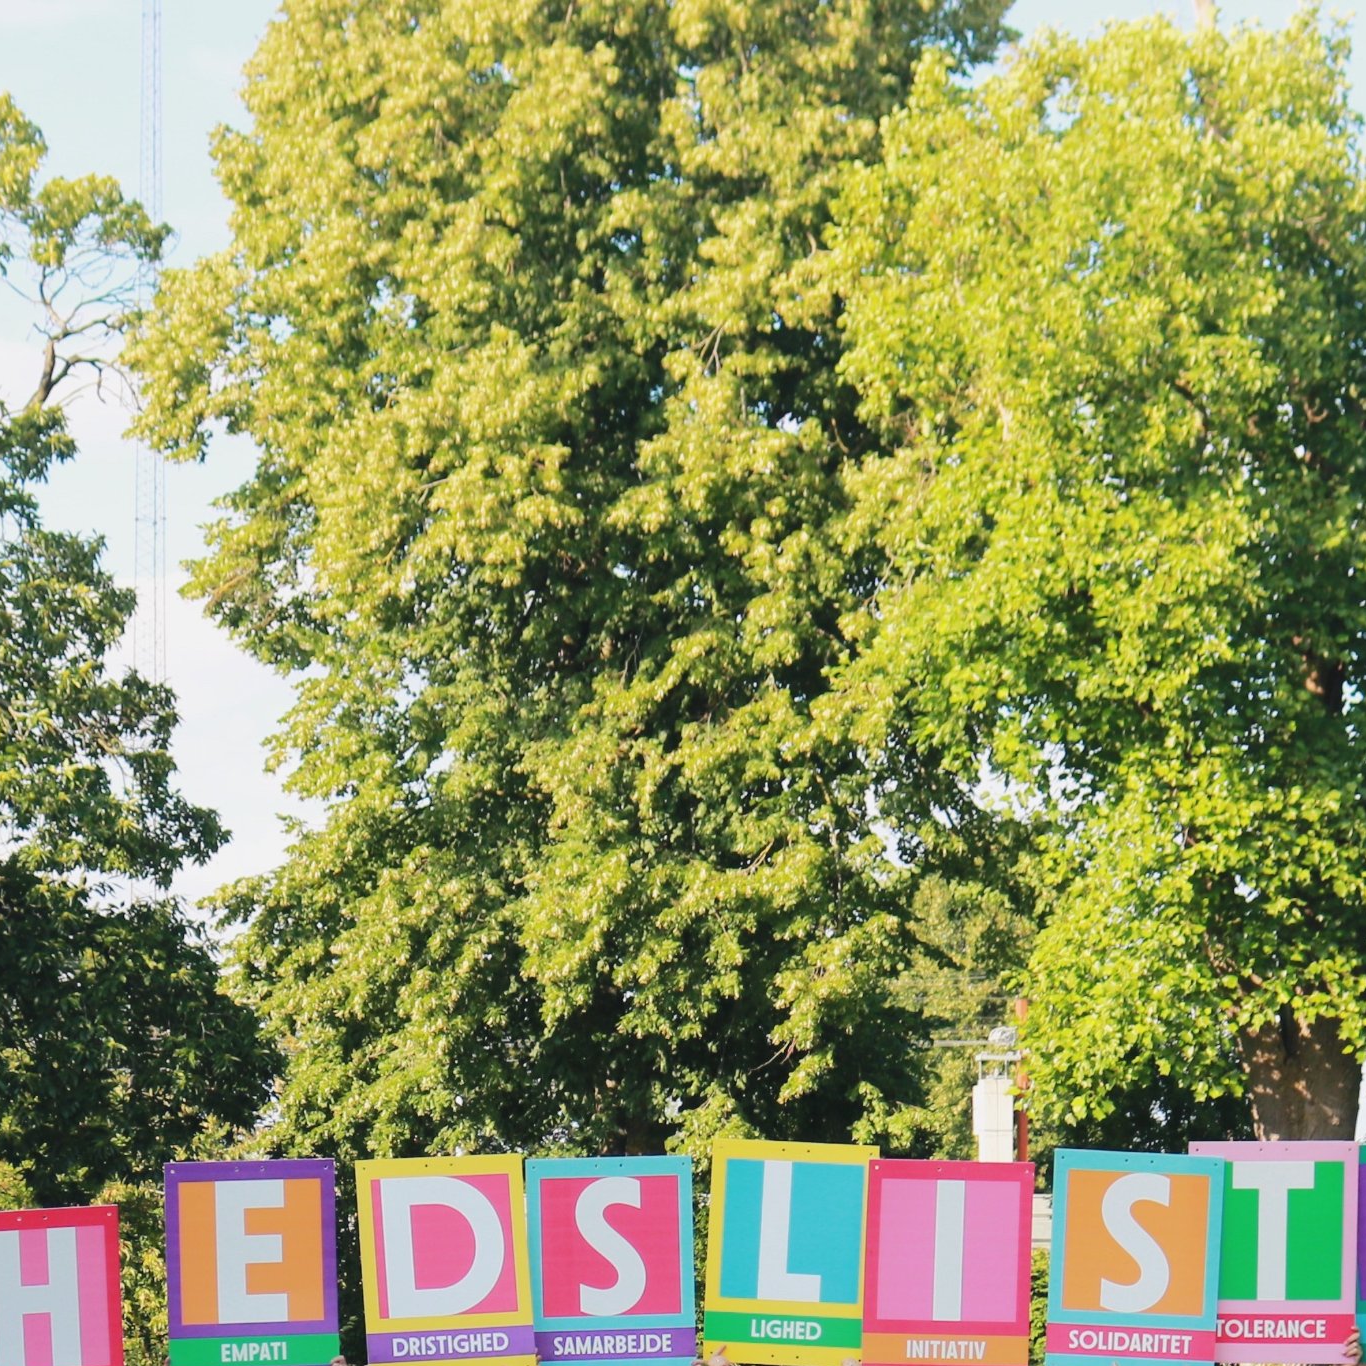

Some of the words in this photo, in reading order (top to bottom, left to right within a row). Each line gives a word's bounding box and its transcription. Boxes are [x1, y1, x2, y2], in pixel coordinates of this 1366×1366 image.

[214, 1179, 293, 1324] E
[380, 1175, 505, 1318] D
[575, 1176, 647, 1317] S
[756, 1159, 823, 1302] L
[933, 1180, 965, 1321] I
[1099, 1172, 1171, 1315] S
[1231, 1160, 1316, 1301] T
[221, 1342, 287, 1362] EMPATI
[393, 1333, 508, 1356] DRISTIGHED
[554, 1334, 671, 1355] SAMARBEJDE
[751, 1320, 821, 1340] LIGHED
[907, 1340, 986, 1359] INITIATIV
[1068, 1329, 1192, 1355] SOLIDARITET
[1216, 1320, 1325, 1338] TOLERANCE
